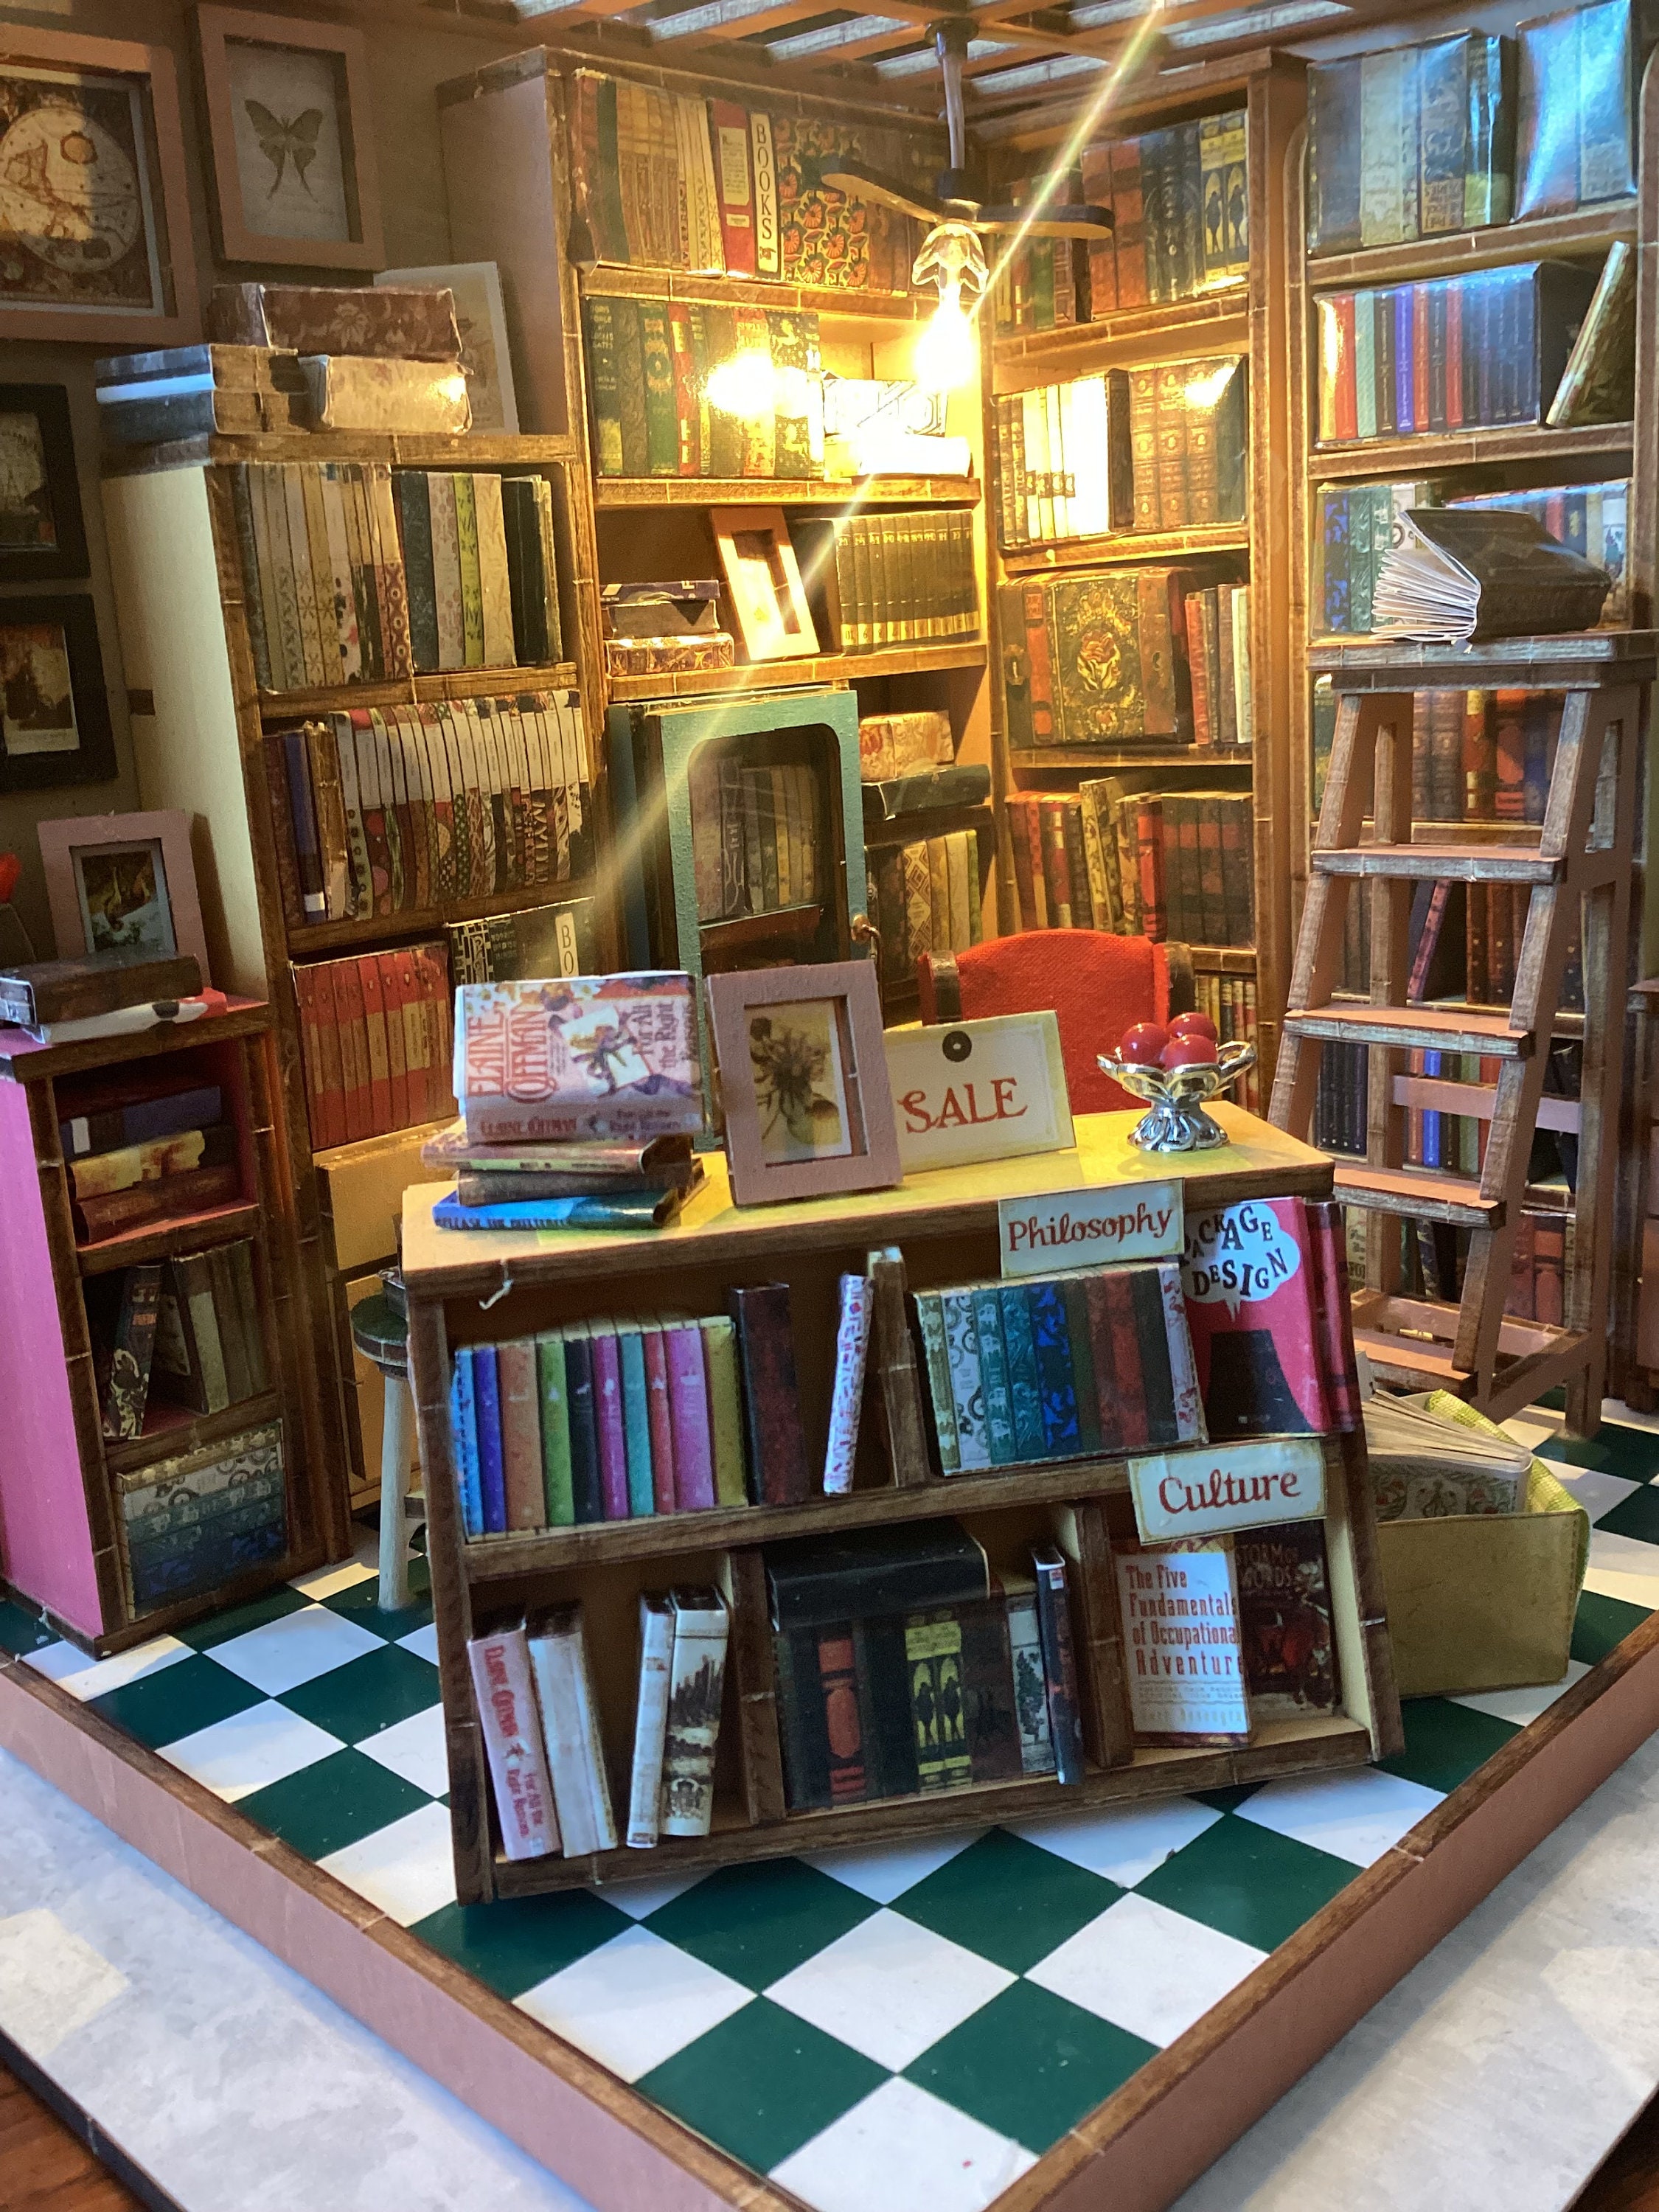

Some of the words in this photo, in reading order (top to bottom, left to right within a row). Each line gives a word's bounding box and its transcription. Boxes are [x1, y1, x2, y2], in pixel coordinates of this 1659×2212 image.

[756, 123, 772, 240] BOOKS
[467, 1001, 506, 1097] ELAINE
[897, 1077, 1028, 1134] SALE
[1009, 1200, 1174, 1252] Philosophy
[1192, 1248, 1288, 1298] DESIGN
[1158, 1468, 1301, 1515] Culture
[1125, 1565, 1152, 1590] The
[1155, 1564, 1188, 1589] Five
[1128, 1591, 1237, 1617] Fundamentals
[1132, 1621, 1147, 1645] of
